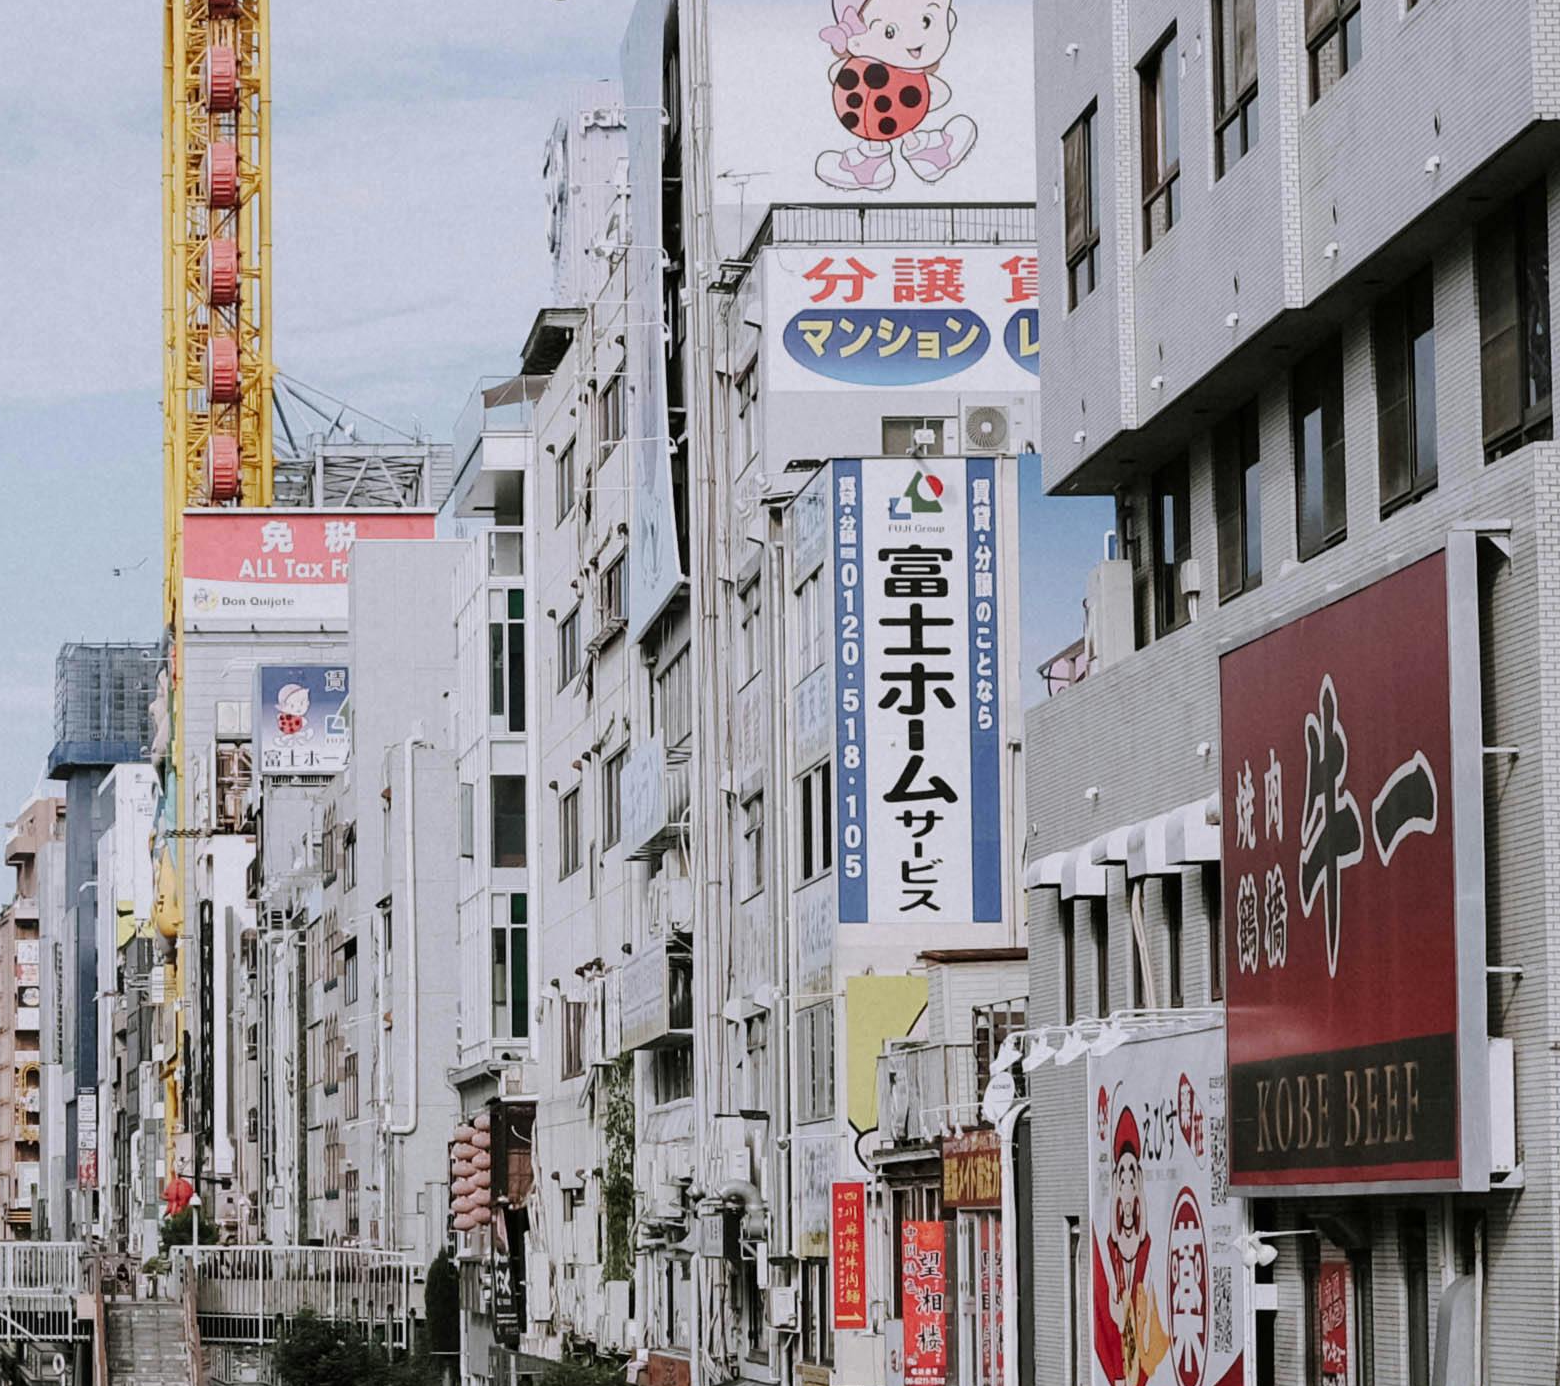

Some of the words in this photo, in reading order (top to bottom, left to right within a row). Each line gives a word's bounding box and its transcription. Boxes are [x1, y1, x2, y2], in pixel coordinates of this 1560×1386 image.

[803, 256, 966, 304] 分譲
[795, 315, 983, 360] マンション
[261, 520, 357, 555] 免税
[914, 524, 945, 534] Group
[239, 559, 277, 579] ALL
[285, 559, 323, 579] Tax
[222, 596, 246, 607] Don
[250, 596, 295, 611] Quijote
[877, 543, 959, 913] 富士ホームサービス
[1254, 1072, 1333, 1154] KOBE
[1344, 1060, 1423, 1148] BEEF
